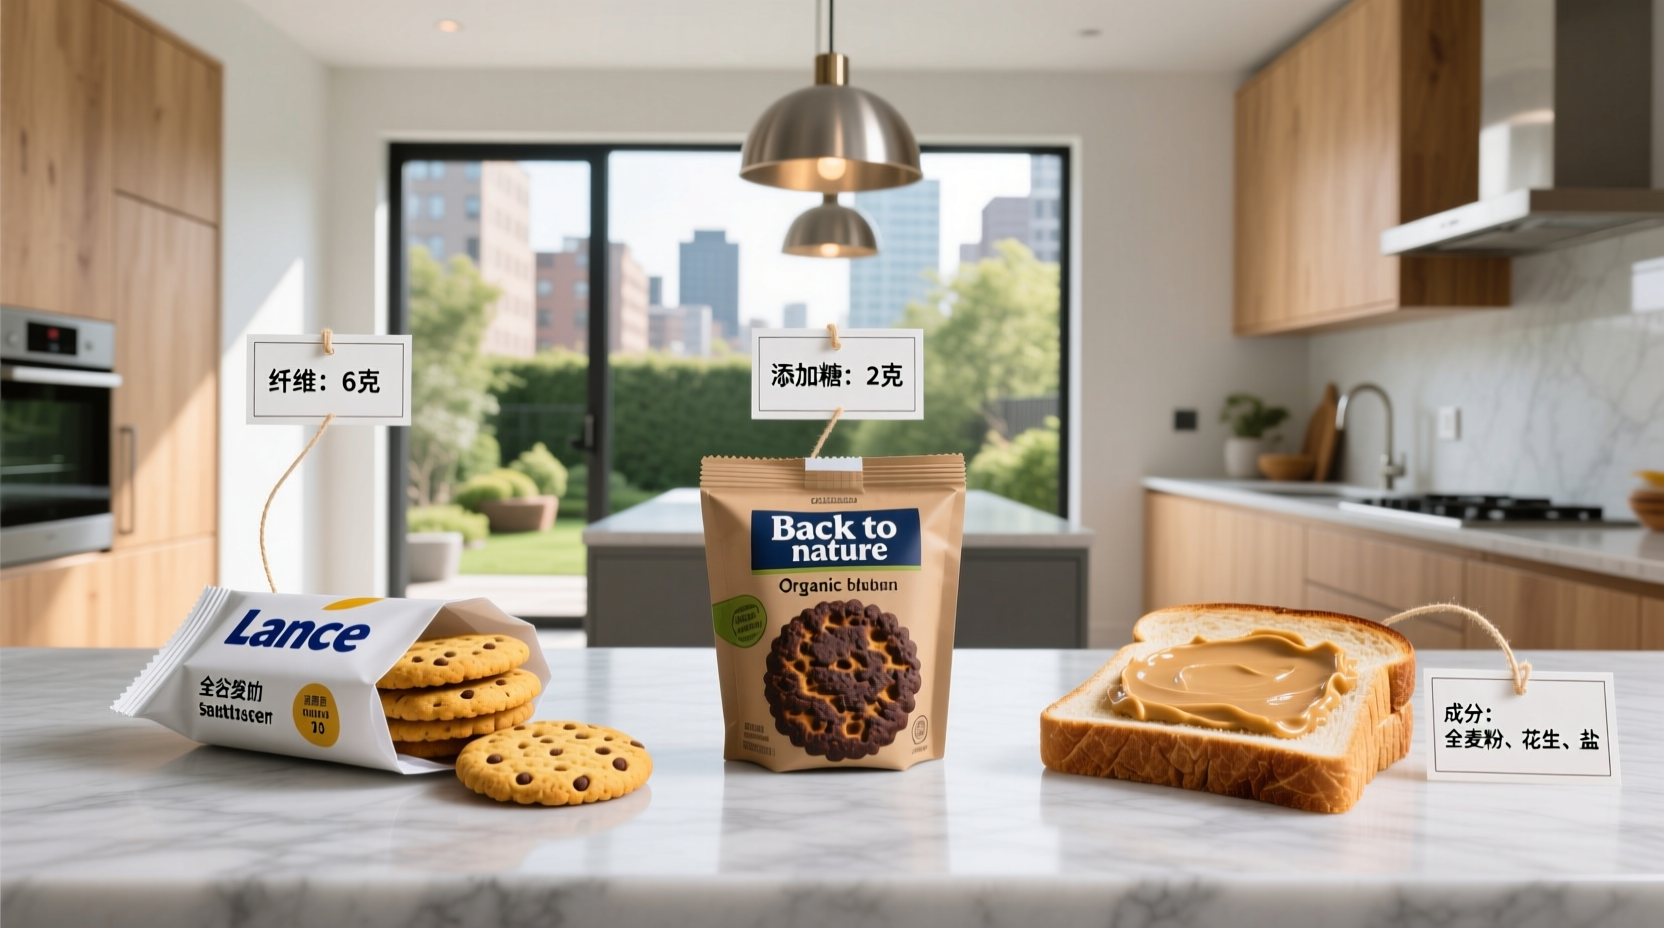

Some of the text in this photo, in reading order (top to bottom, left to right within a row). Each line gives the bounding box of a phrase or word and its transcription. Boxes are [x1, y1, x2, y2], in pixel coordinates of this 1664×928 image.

[268, 368, 381, 394] 纤维：6克
[771, 362, 903, 388] 添加糖：2克
[771, 514, 897, 541] Back to
[792, 539, 888, 562] nature
[779, 577, 842, 596] Organic
[224, 609, 370, 653] Lance
[1444, 703, 1492, 724] 成分：
[1445, 728, 1600, 751] 全麦粉、花生、盐
